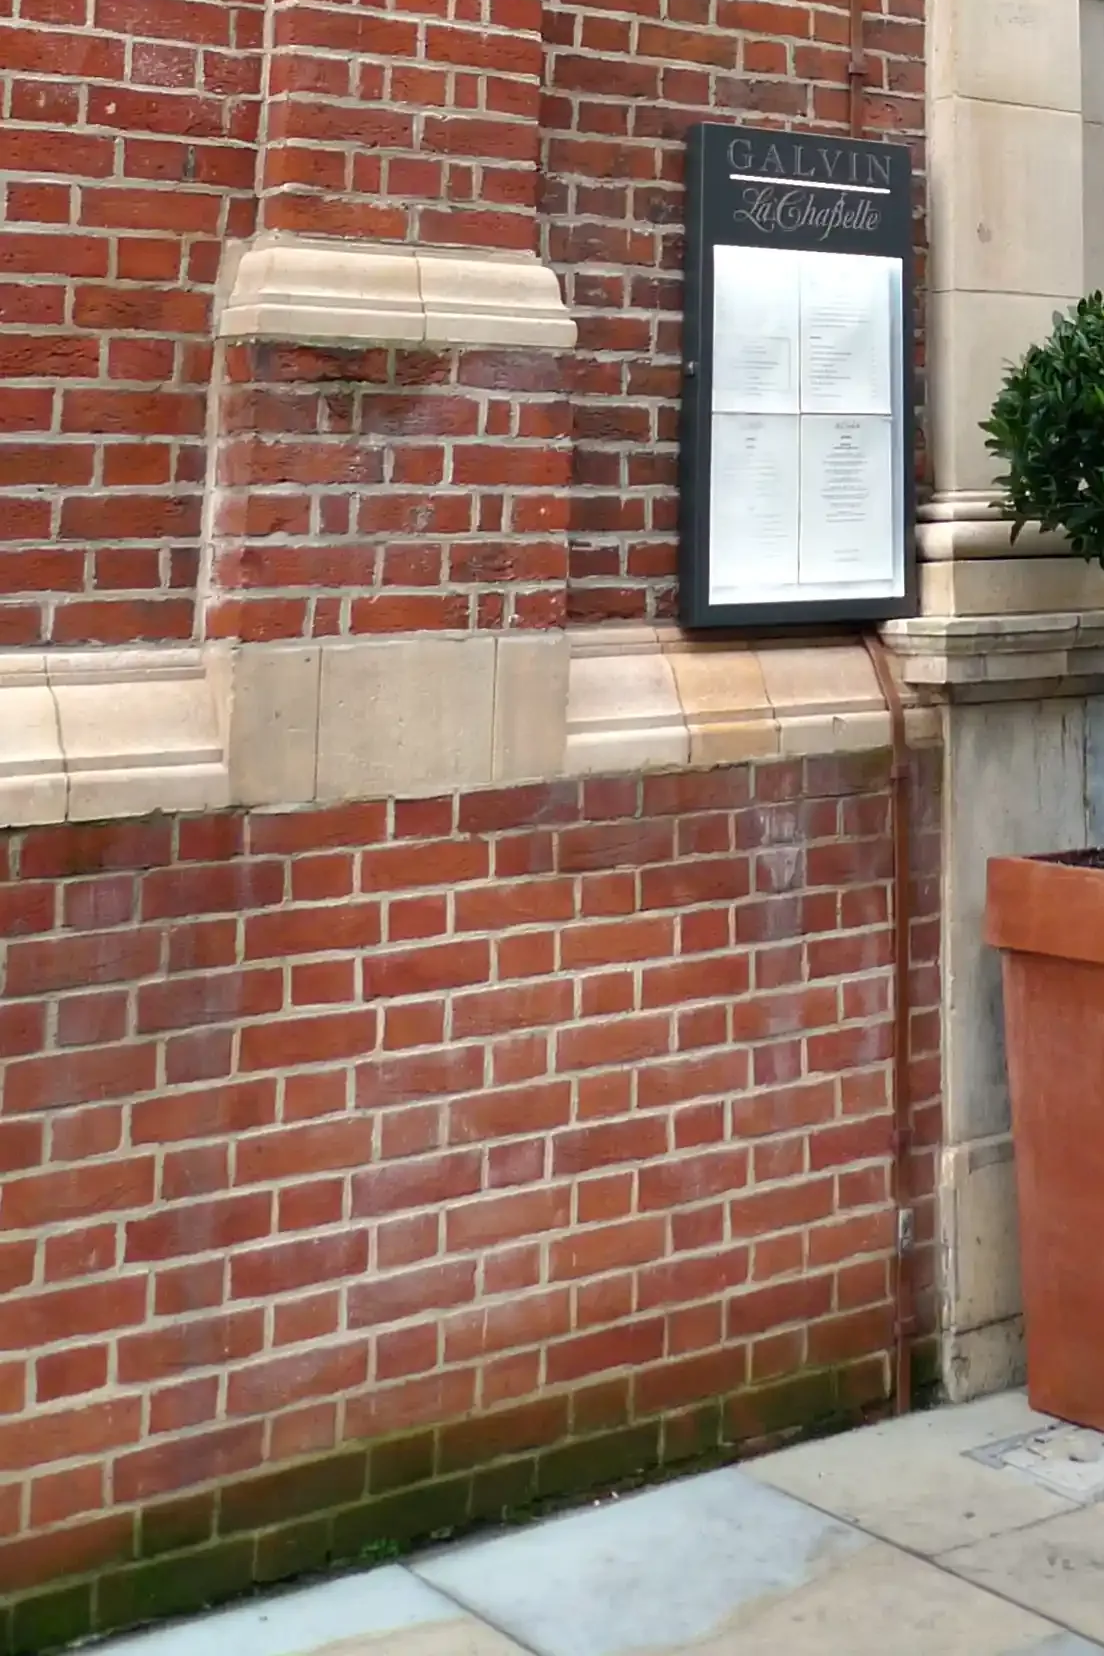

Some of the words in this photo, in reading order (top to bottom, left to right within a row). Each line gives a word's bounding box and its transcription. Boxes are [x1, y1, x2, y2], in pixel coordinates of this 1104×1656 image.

[728, 138, 892, 184] GALVIN
[734, 187, 776, 233] La
[777, 189, 880, 241] Chapelle
